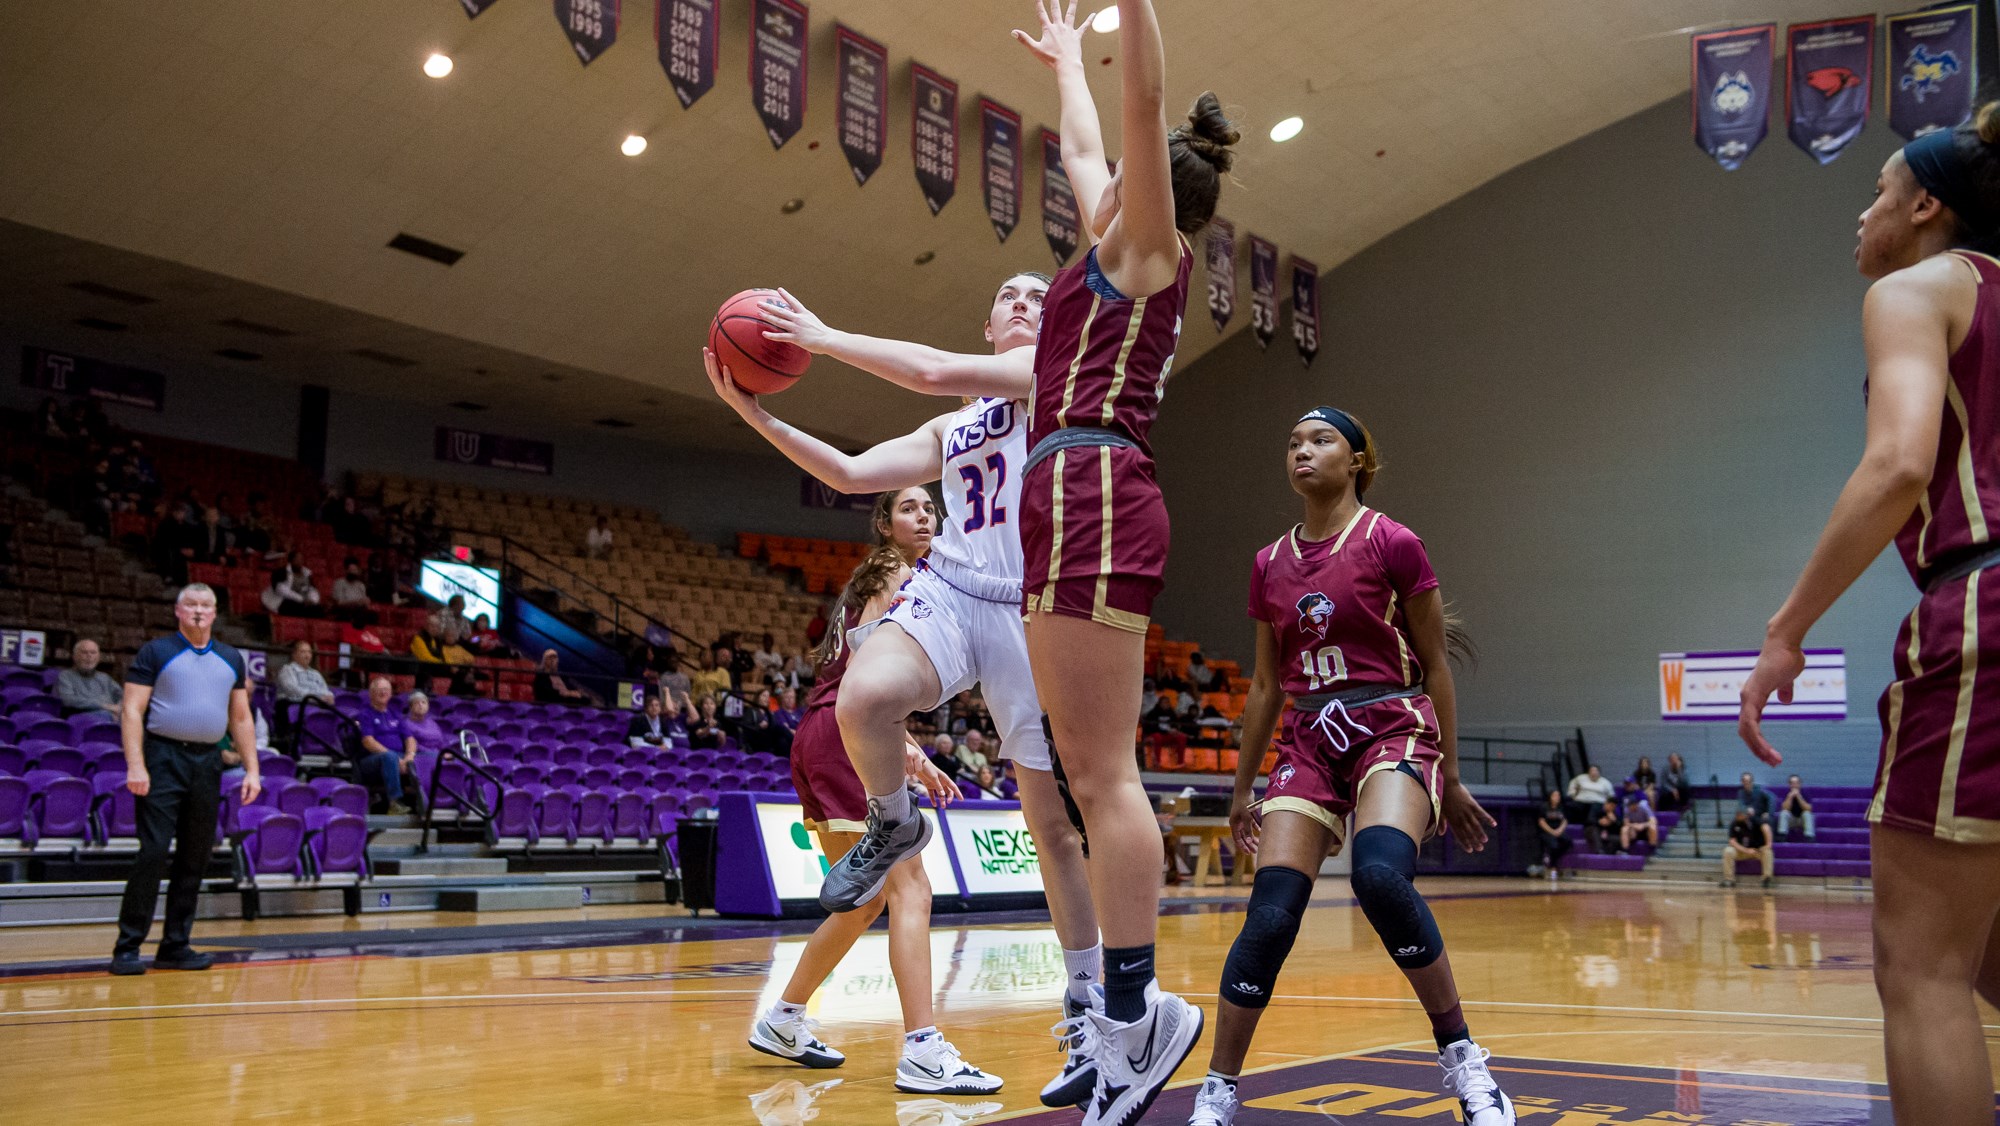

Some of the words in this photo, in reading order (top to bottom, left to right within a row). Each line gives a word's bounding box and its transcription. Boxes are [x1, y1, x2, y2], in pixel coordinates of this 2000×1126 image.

[671, 57, 700, 84] 2015
[764, 96, 790, 121] 2015
[1208, 284, 1231, 315] 25
[1252, 303, 1274, 334] 33
[1293, 321, 1317, 351] 45
[47, 354, 74, 390] T
[947, 402, 1013, 459] NSU
[454, 431, 481, 462] U
[958, 451, 1007, 535] 32
[2, 635, 20, 657] F
[249, 657, 266, 678] G
[1301, 645, 1348, 691] 10
[632, 688, 644, 706] G
[1662, 661, 1684, 712] W
